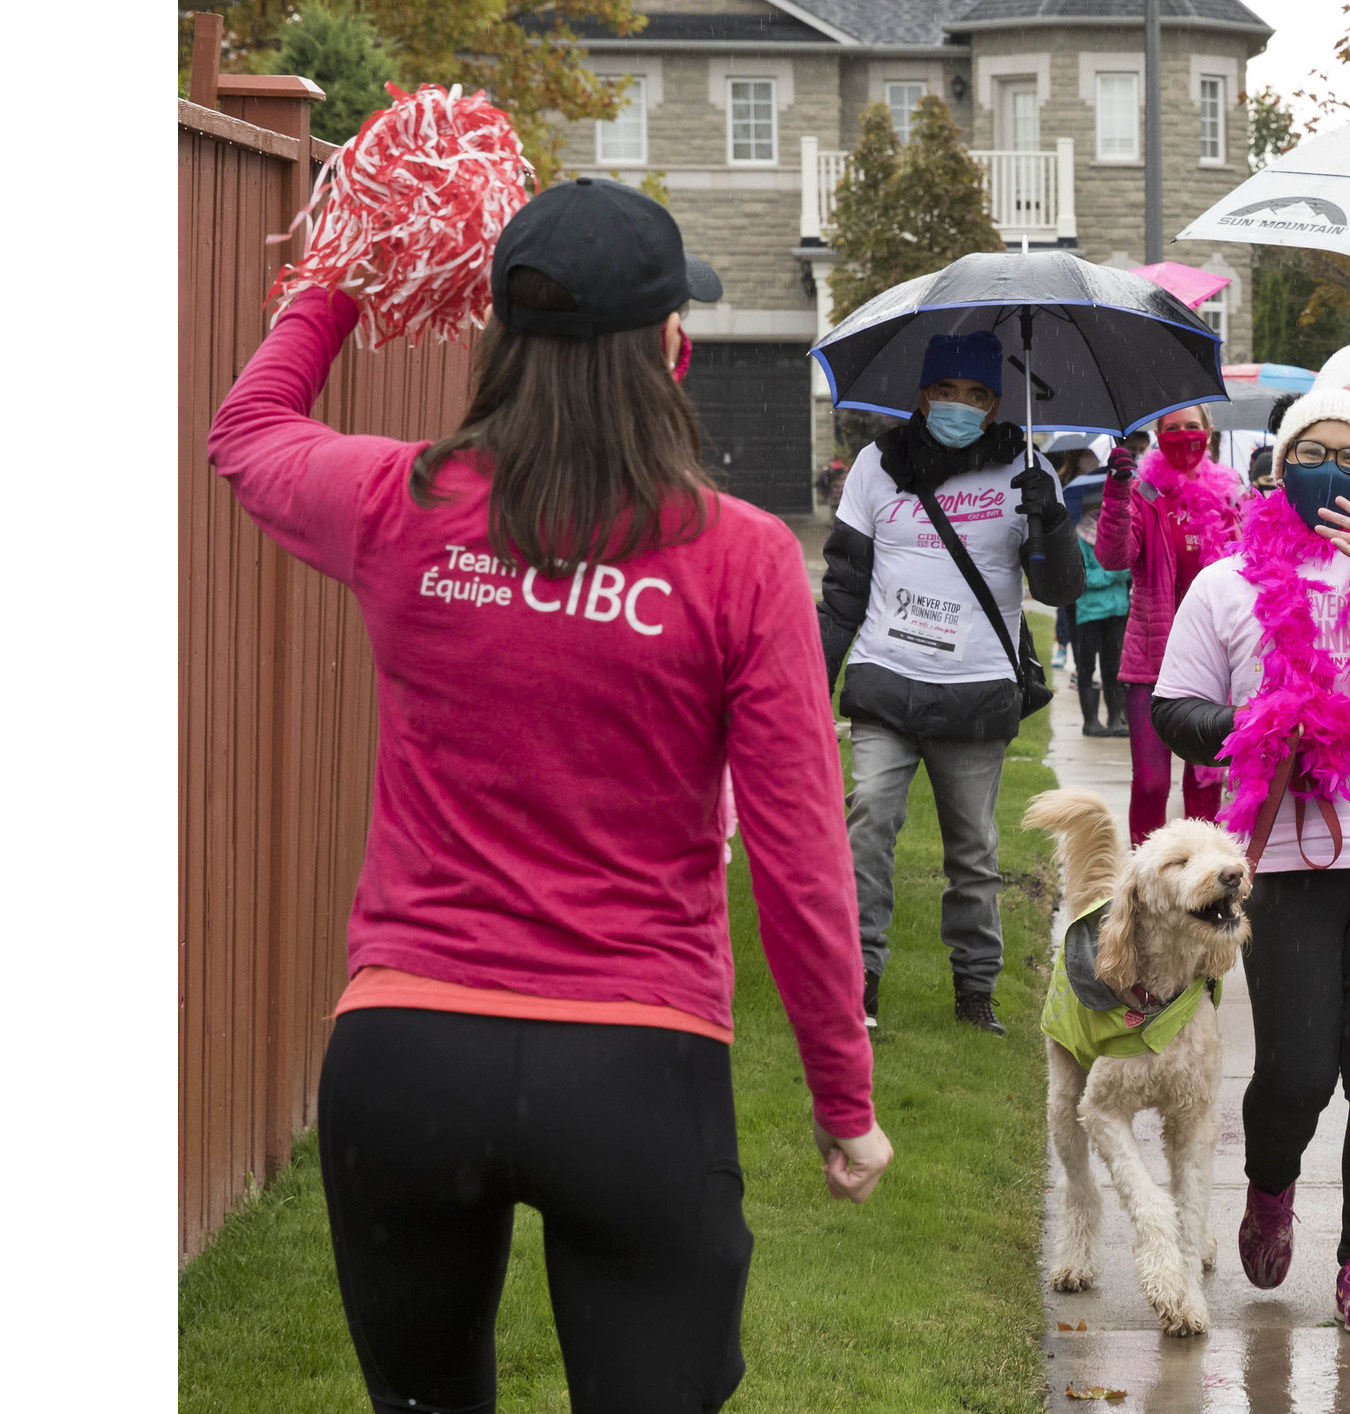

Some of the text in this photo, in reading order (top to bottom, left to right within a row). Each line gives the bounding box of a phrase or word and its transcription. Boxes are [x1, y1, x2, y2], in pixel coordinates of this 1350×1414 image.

[1217, 217, 1345, 235] SUN MOUNTAIN
[886, 498, 912, 524] I
[445, 544, 517, 578] Team
[420, 566, 512, 607] Équipe
[522, 558, 672, 636] CIBC
[911, 605, 960, 626] RUNNING FOR
[917, 595, 941, 610] NEVER
[942, 601, 961, 614] STOP
